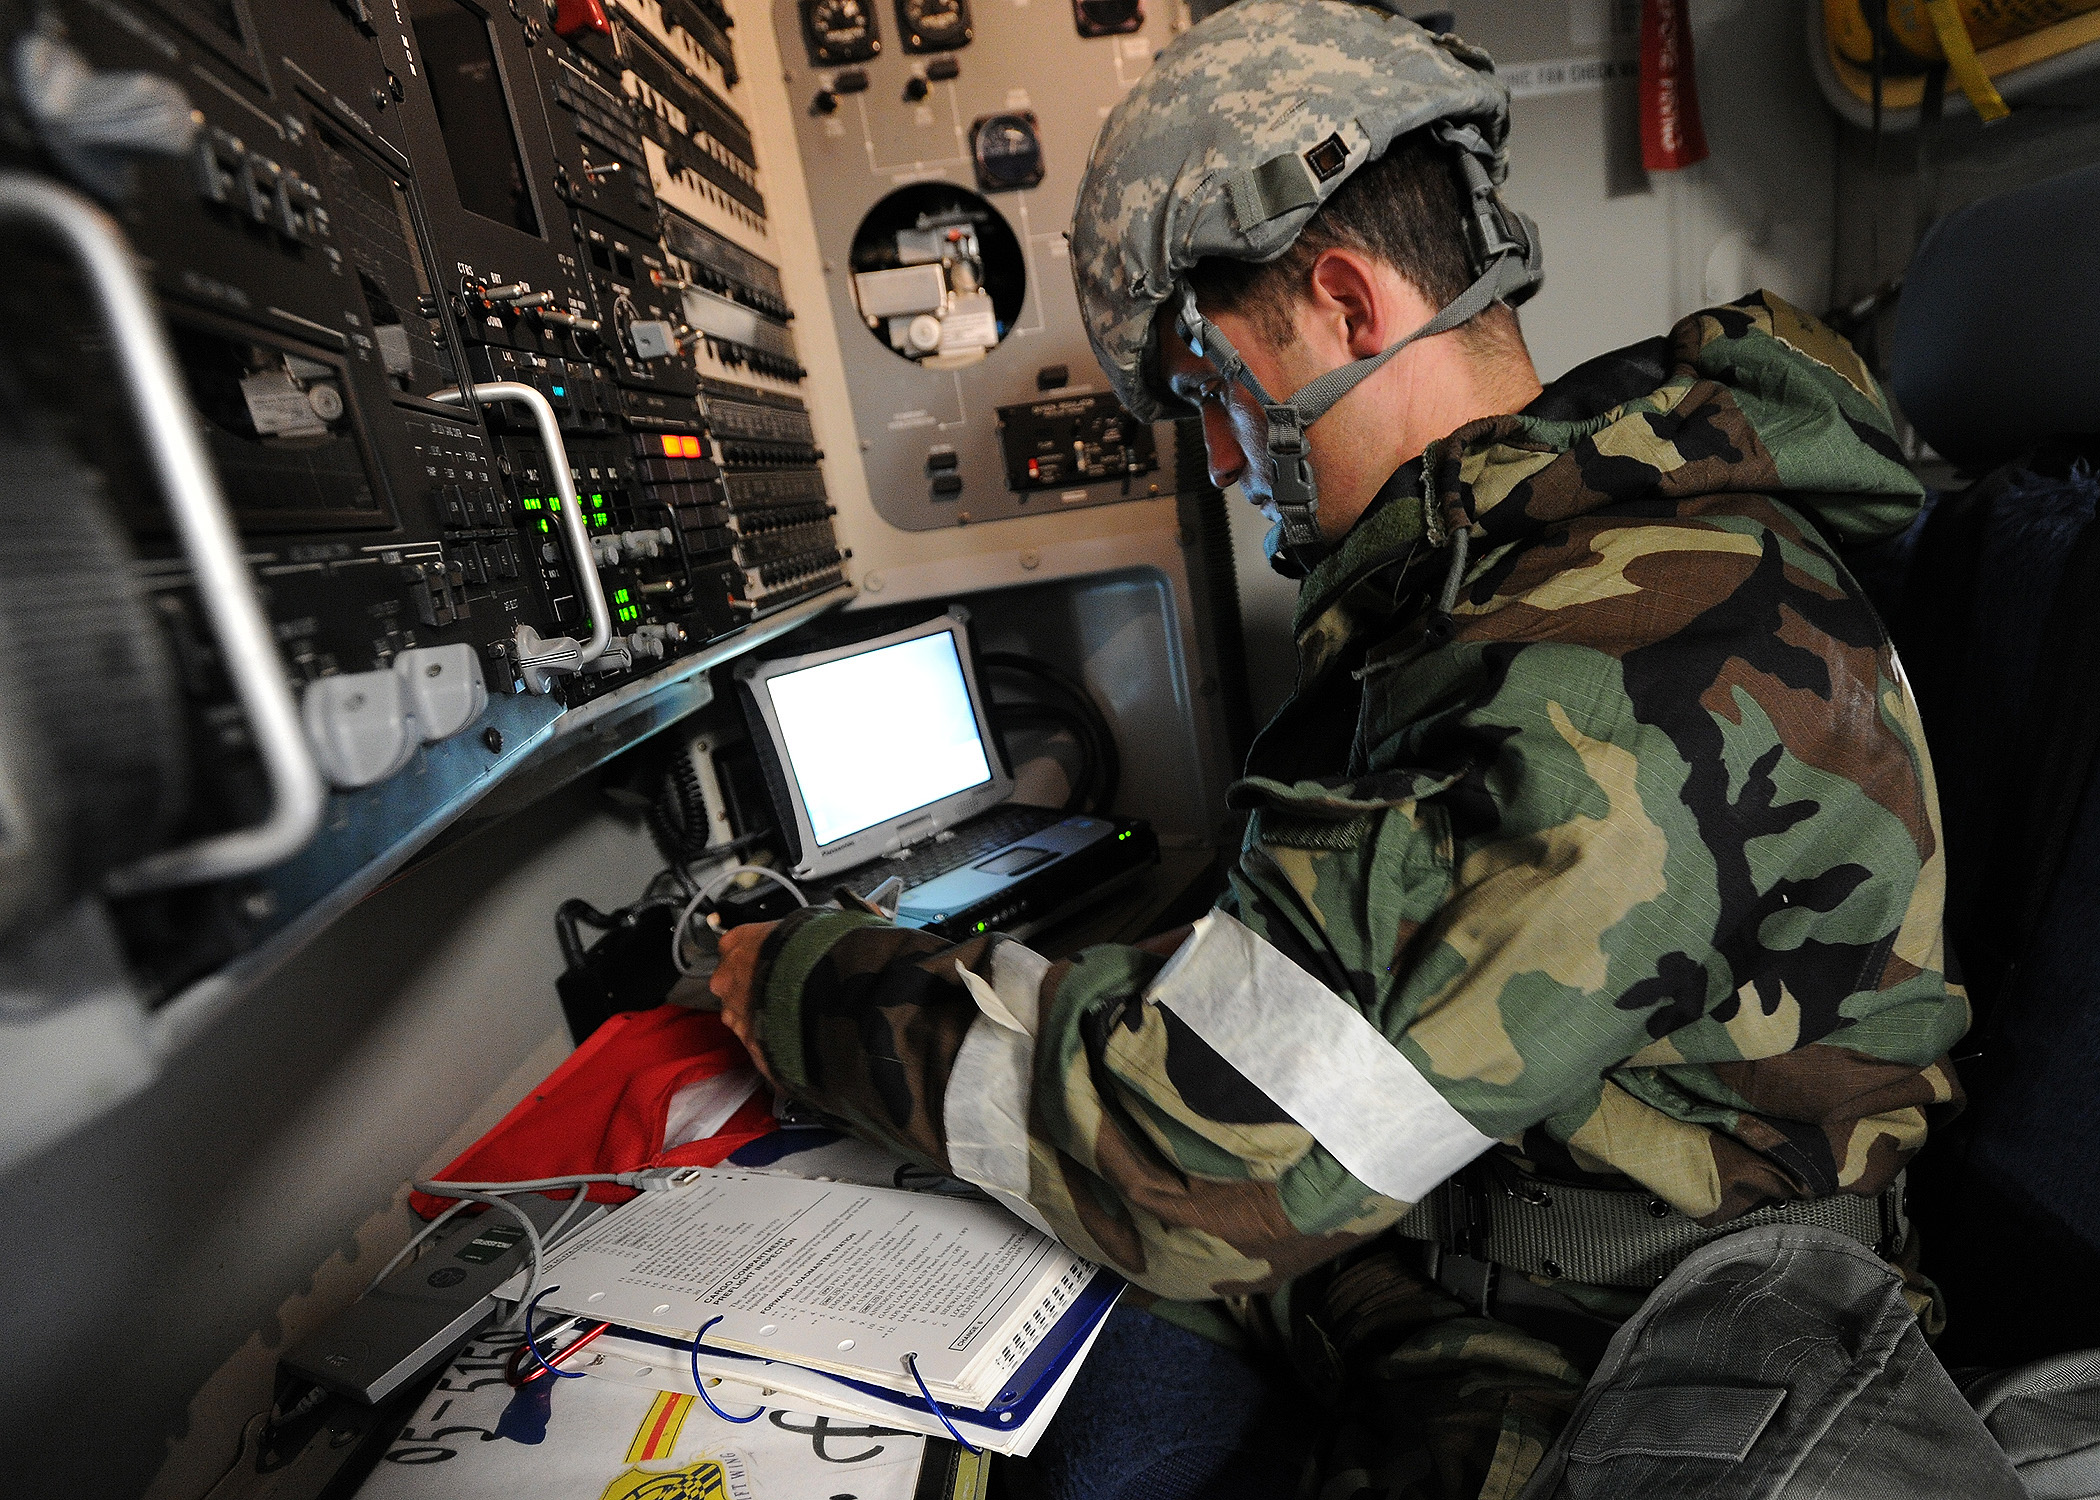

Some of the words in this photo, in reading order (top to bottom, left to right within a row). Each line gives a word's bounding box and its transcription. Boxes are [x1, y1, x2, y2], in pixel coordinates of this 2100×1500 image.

[700, 1279, 736, 1304] CARGO
[729, 1236, 788, 1280] COMPARTMENT
[710, 1270, 758, 1306] PREFLIGHT
[752, 1237, 799, 1271] INSPECTION
[758, 1286, 795, 1315] FORWARD
[790, 1252, 834, 1287] LOADMASTER
[830, 1232, 858, 1252] STATION
[780, 1246, 815, 1272] compartment
[836, 1292, 861, 1311] CARGO
[954, 1324, 978, 1347] CHANGE
[720, 1451, 746, 1481] WING
